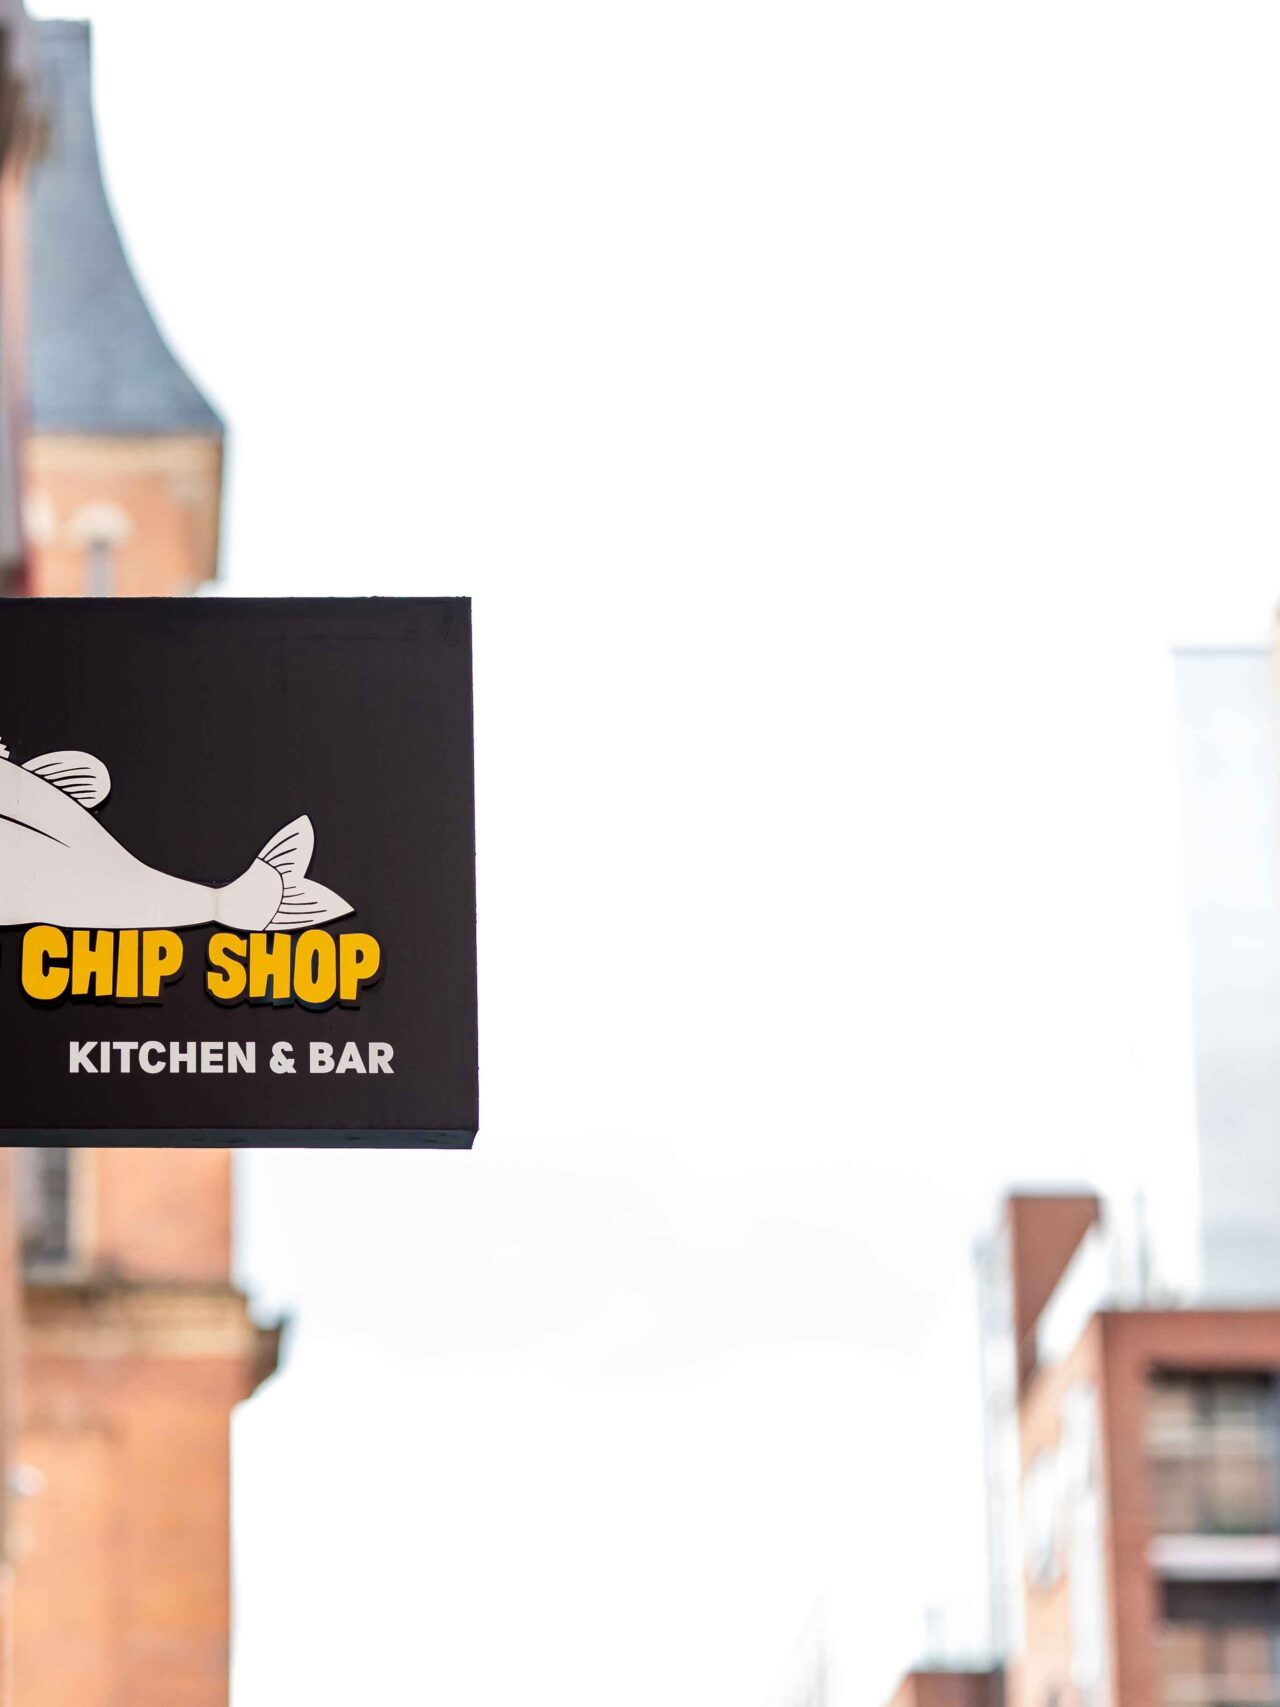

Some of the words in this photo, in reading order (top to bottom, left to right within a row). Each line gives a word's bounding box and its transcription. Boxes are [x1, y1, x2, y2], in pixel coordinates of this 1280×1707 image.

[21, 924, 184, 1000] CHIP
[207, 928, 381, 1004] SHOP
[68, 1040, 257, 1075] KITCHEN
[269, 1040, 297, 1075] &
[309, 1040, 395, 1075] BAR
